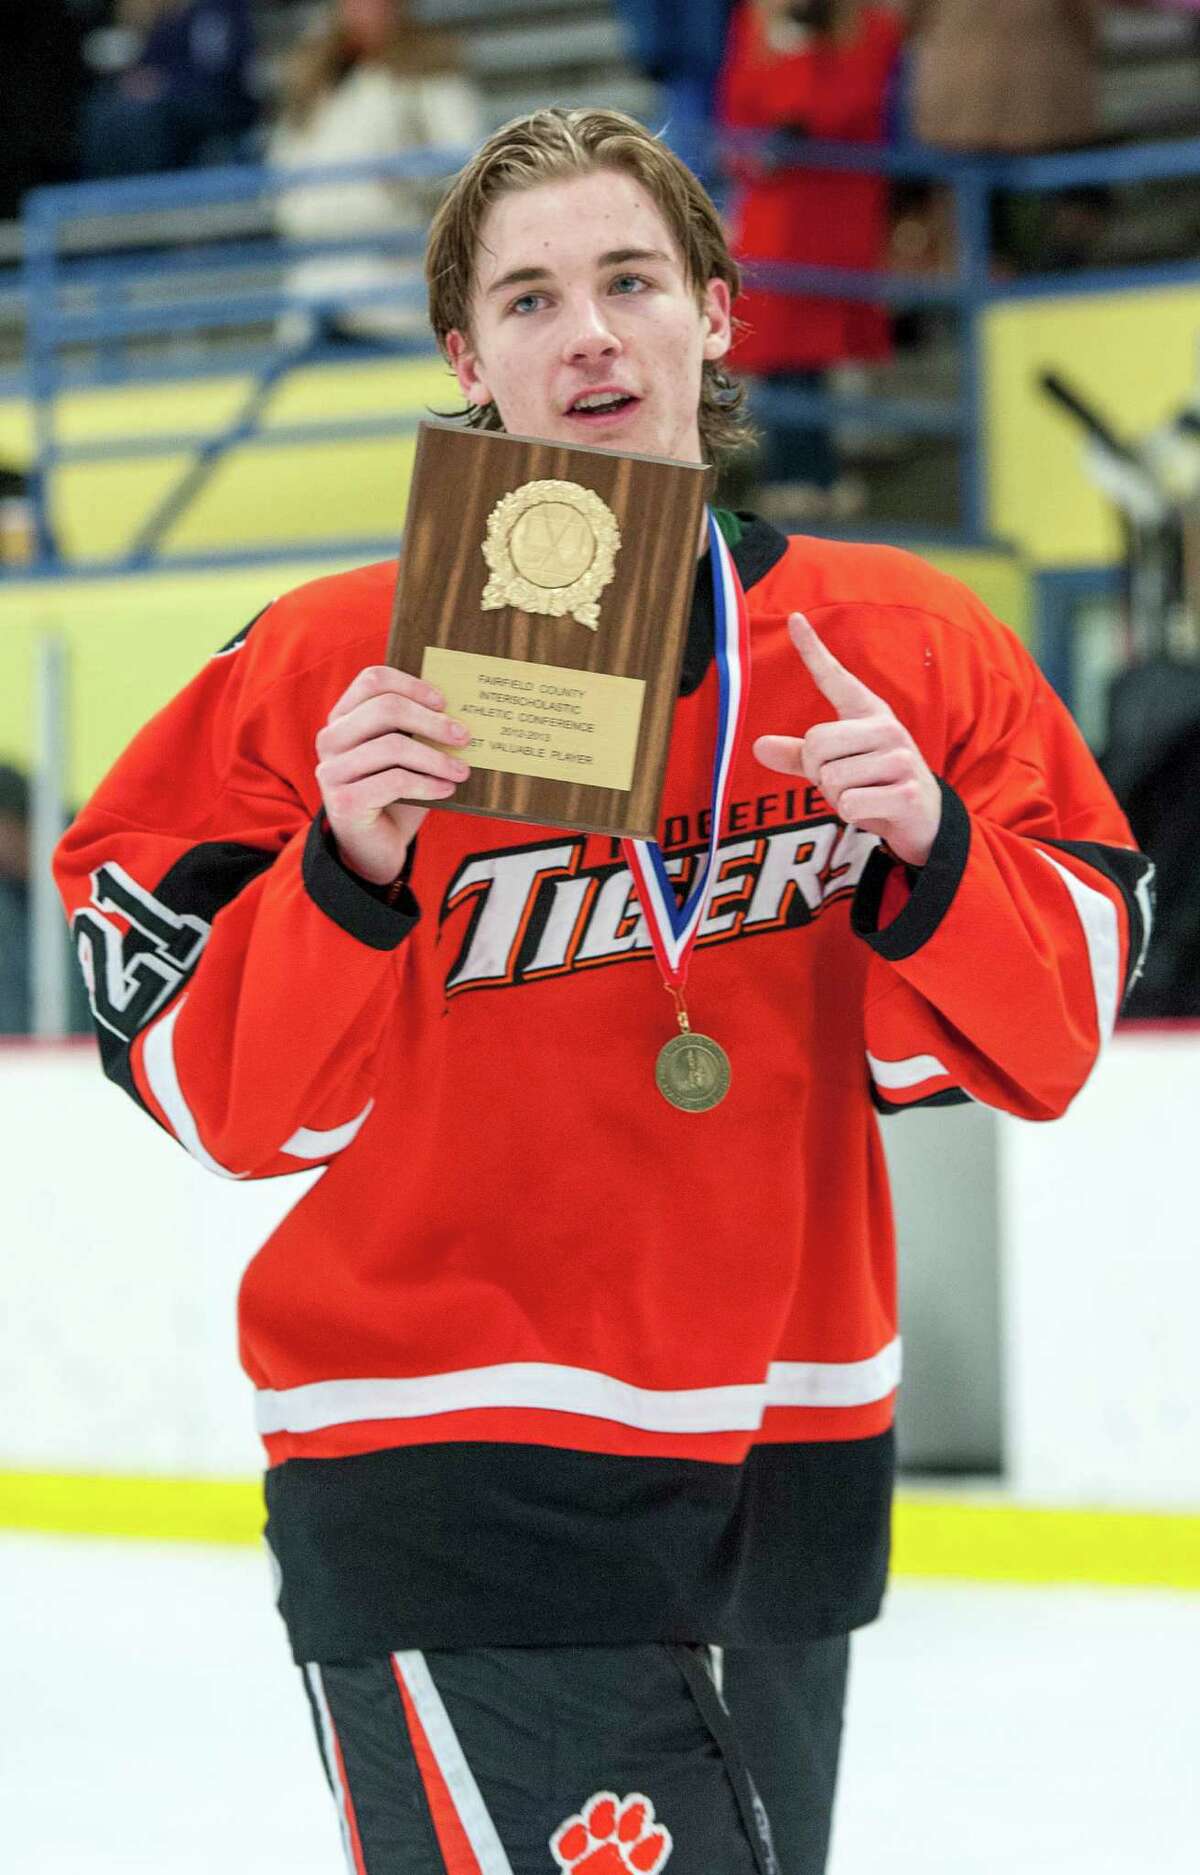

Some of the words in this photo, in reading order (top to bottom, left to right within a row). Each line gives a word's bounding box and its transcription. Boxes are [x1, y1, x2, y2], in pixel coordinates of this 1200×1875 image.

[478, 674, 534, 691] FAIRFIELD
[539, 684, 585, 698] COUNTY
[479, 691, 582, 715] INTERSCHOLASTIC
[460, 704, 513, 720] ATHLETIC
[518, 712, 596, 733] CONFERENCE
[499, 726, 552, 742] 2012-2013
[489, 741, 546, 758] VALUABLE
[550, 750, 594, 765] PLAYER
[436, 815, 881, 999] TIGERS
[71, 861, 212, 1042] 21
